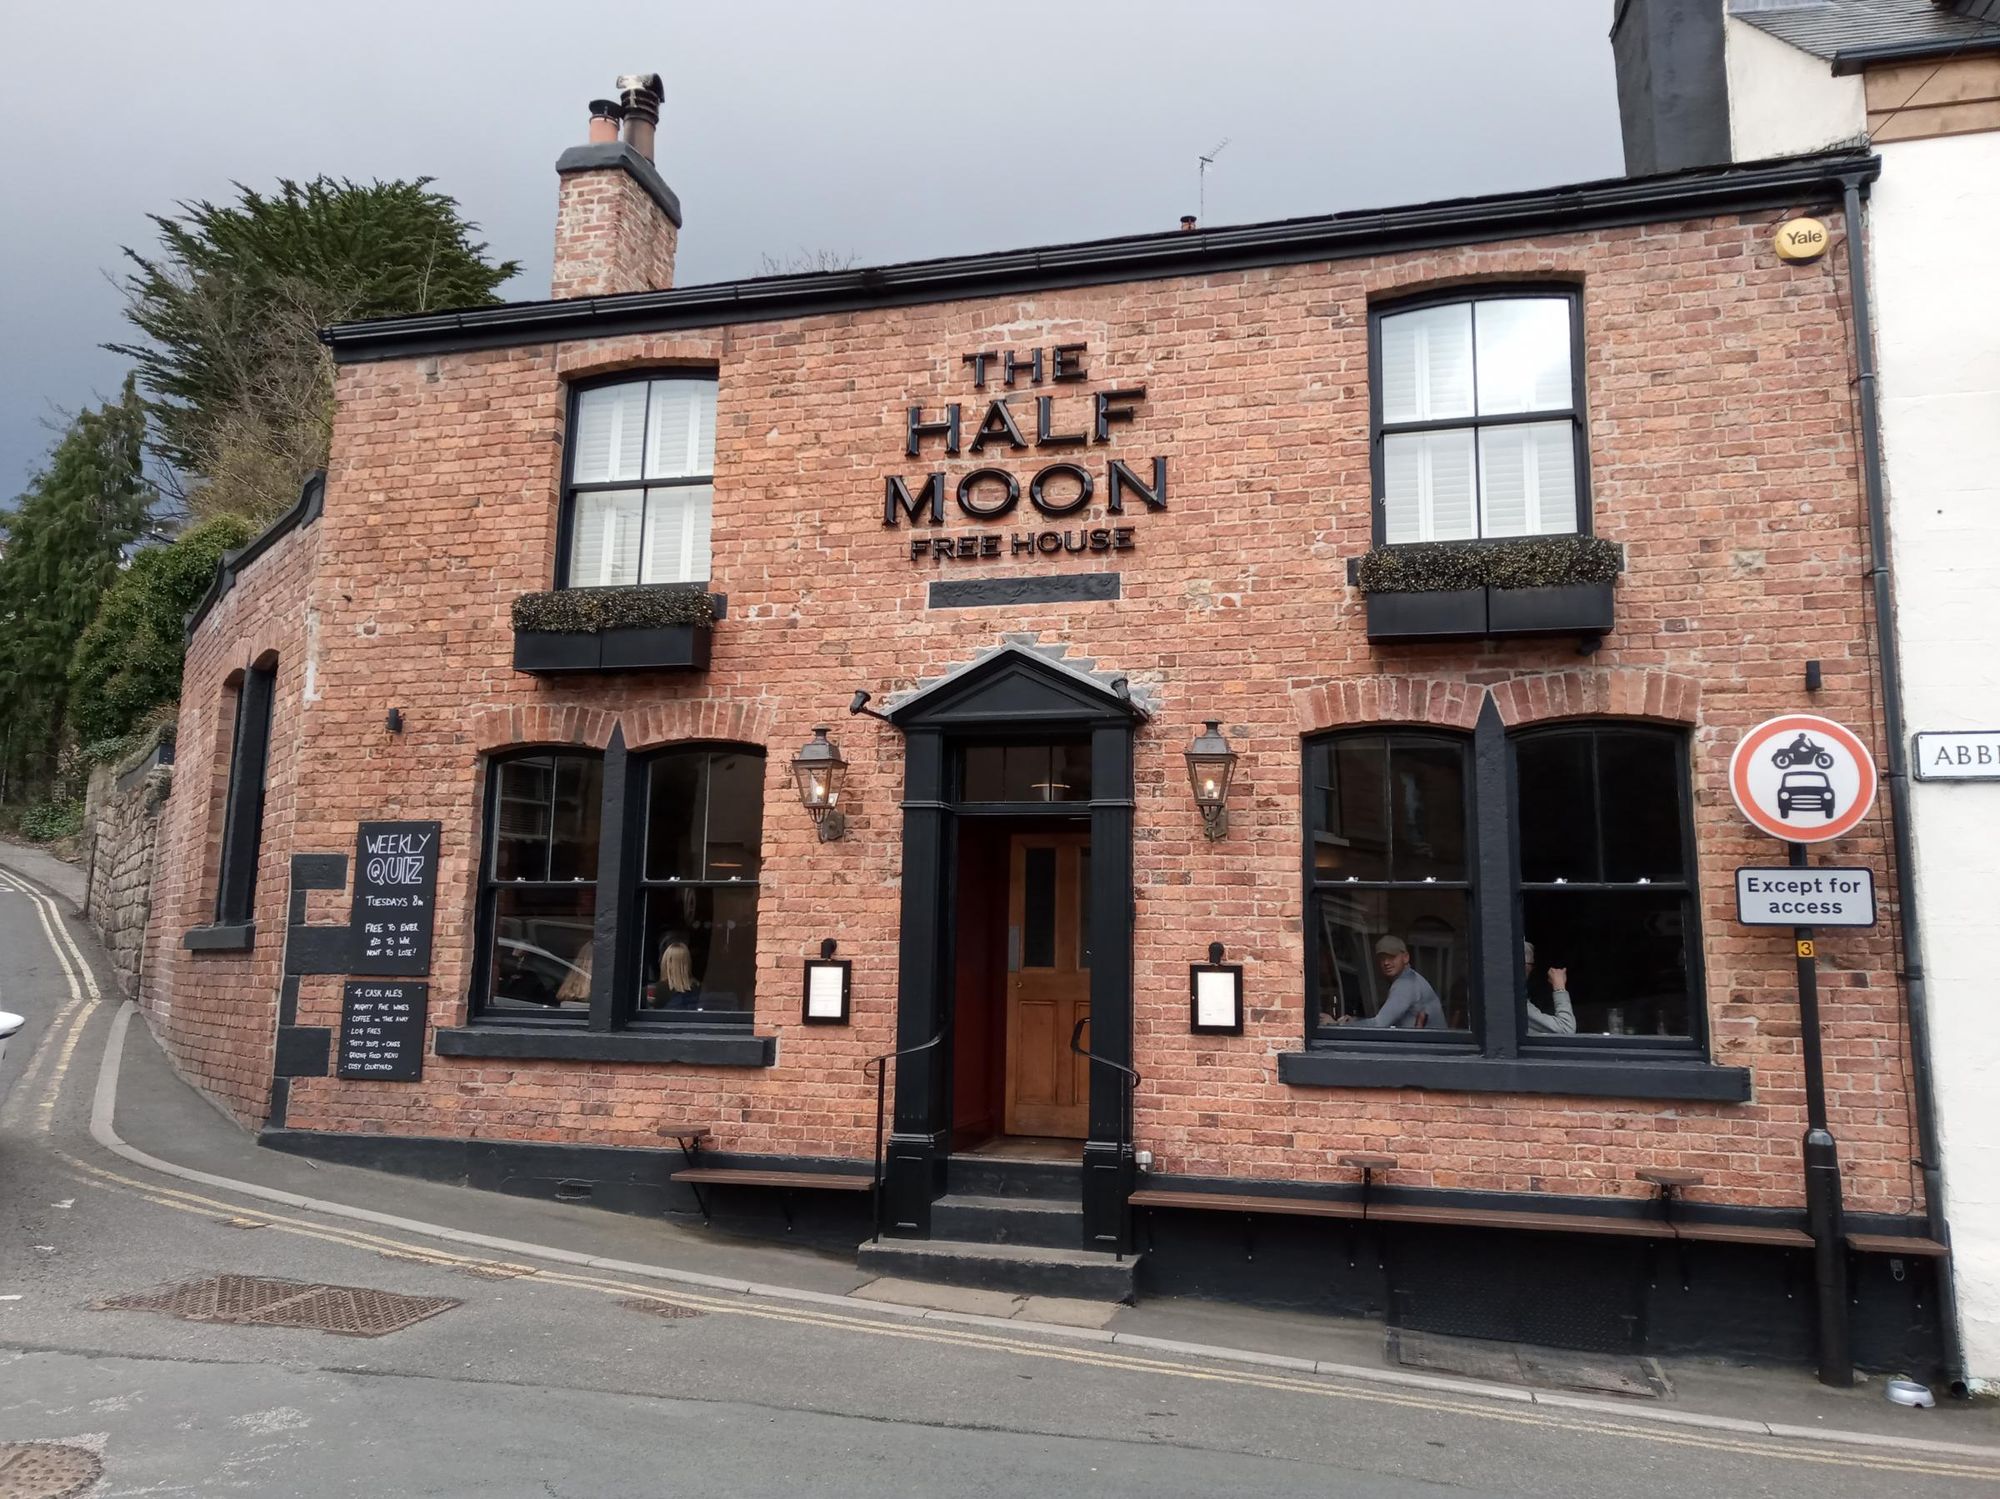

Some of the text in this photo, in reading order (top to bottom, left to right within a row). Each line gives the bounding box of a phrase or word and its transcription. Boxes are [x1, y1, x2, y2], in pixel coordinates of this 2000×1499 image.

[1787, 230, 1822, 245] Yale
[962, 341, 1088, 388] THE
[905, 385, 1146, 456] HALF
[882, 456, 1168, 526] MOON
[910, 526, 1135, 562] FREE HOUSE
[1934, 745, 2000, 766] ABB
[365, 833, 431, 854] WEEKLY
[366, 856, 424, 885] QUIZ
[1747, 877, 1861, 896] Except for
[365, 895, 408, 907] TUESDAYS
[1769, 901, 1843, 914] access
[365, 922, 419, 933] FREE TO ENTER
[386, 937, 395, 945] TO
[1800, 941, 1812, 956] 3
[386, 949, 394, 957] TO
[354, 988, 403, 998] 4 CASK ALES
